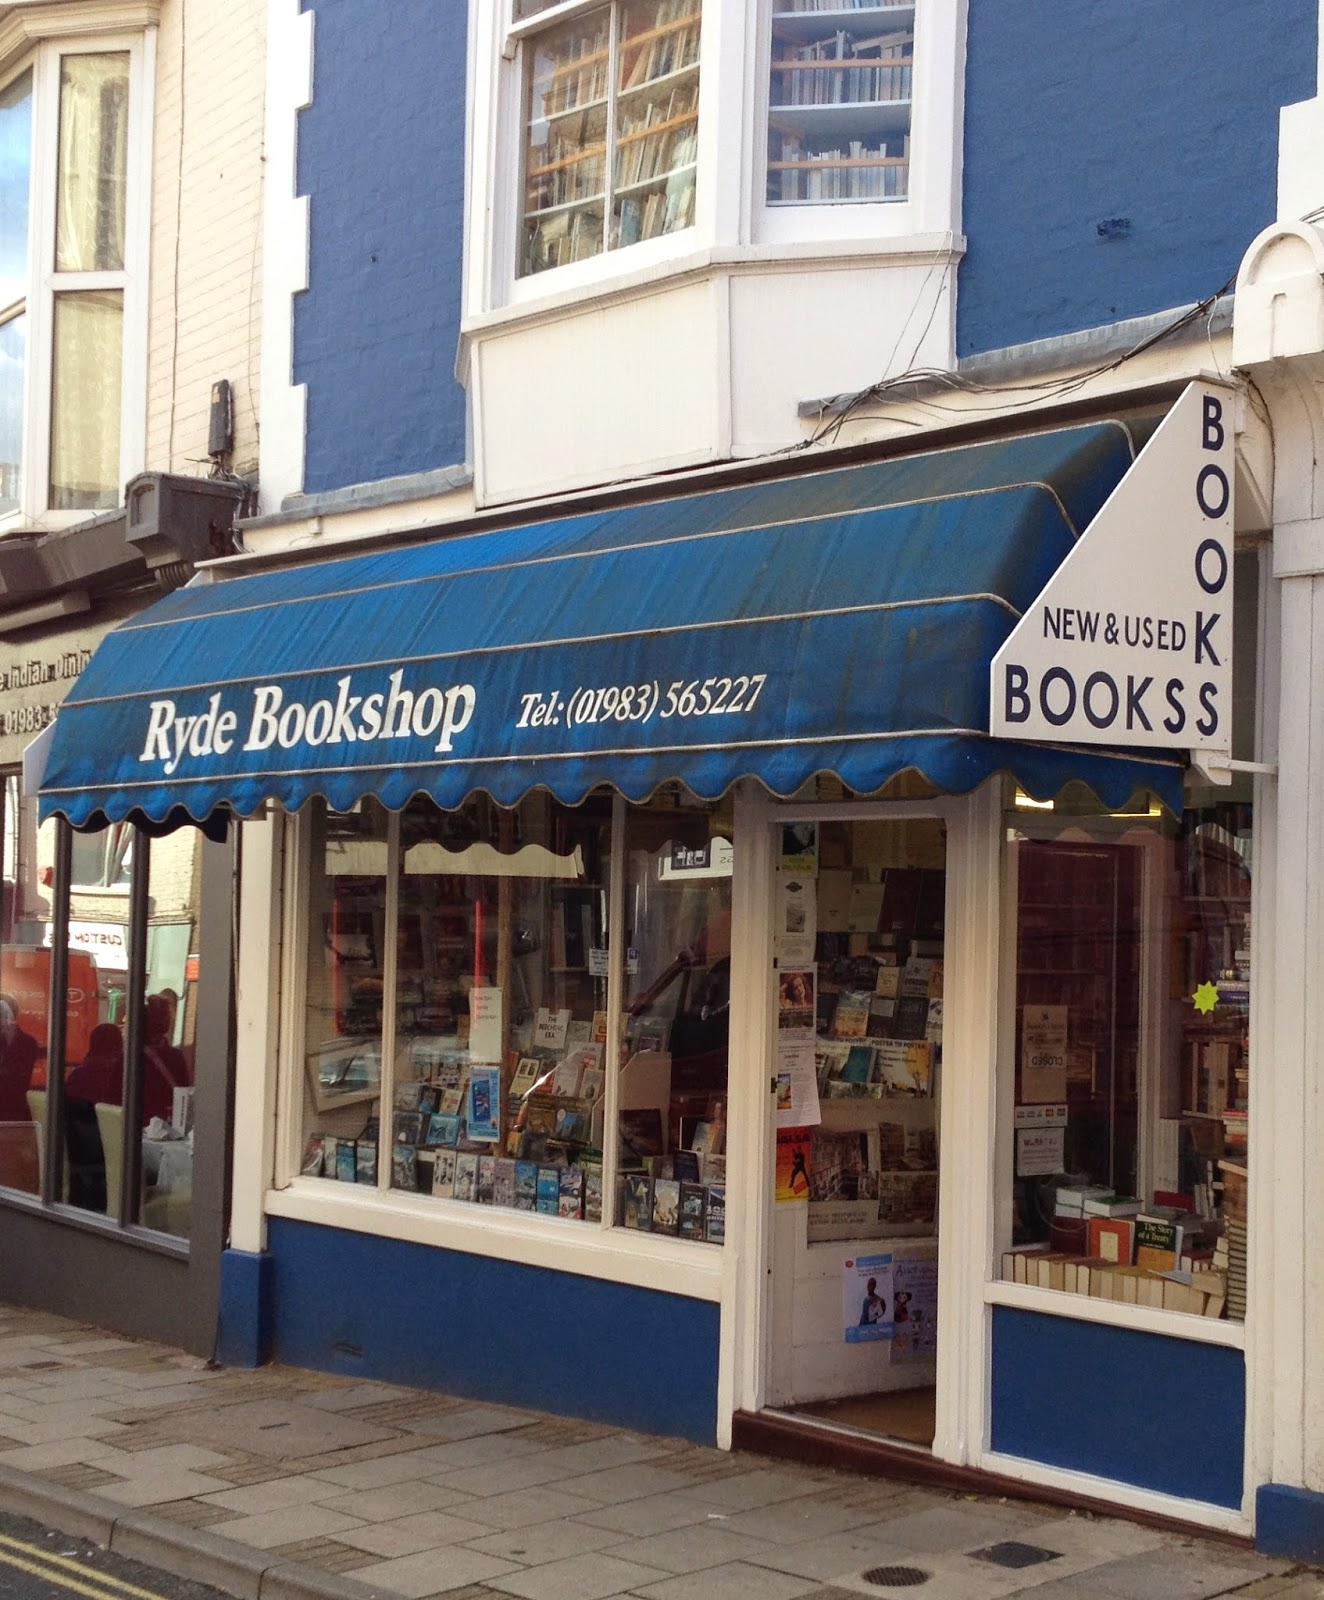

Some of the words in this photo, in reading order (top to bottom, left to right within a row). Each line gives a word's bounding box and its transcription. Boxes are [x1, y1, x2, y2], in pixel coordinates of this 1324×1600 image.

[1043, 606, 1100, 644] NEW
[1103, 613, 1120, 646] &
[1124, 616, 1187, 652] USED
[7, 660, 48, 690] Indian
[5, 704, 42, 735] 01983
[139, 692, 237, 775] Ryde
[243, 668, 476, 753] Bookshop
[516, 692, 563, 729] Tel:
[565, 679, 659, 731] (01983)
[661, 673, 768, 721] 565227
